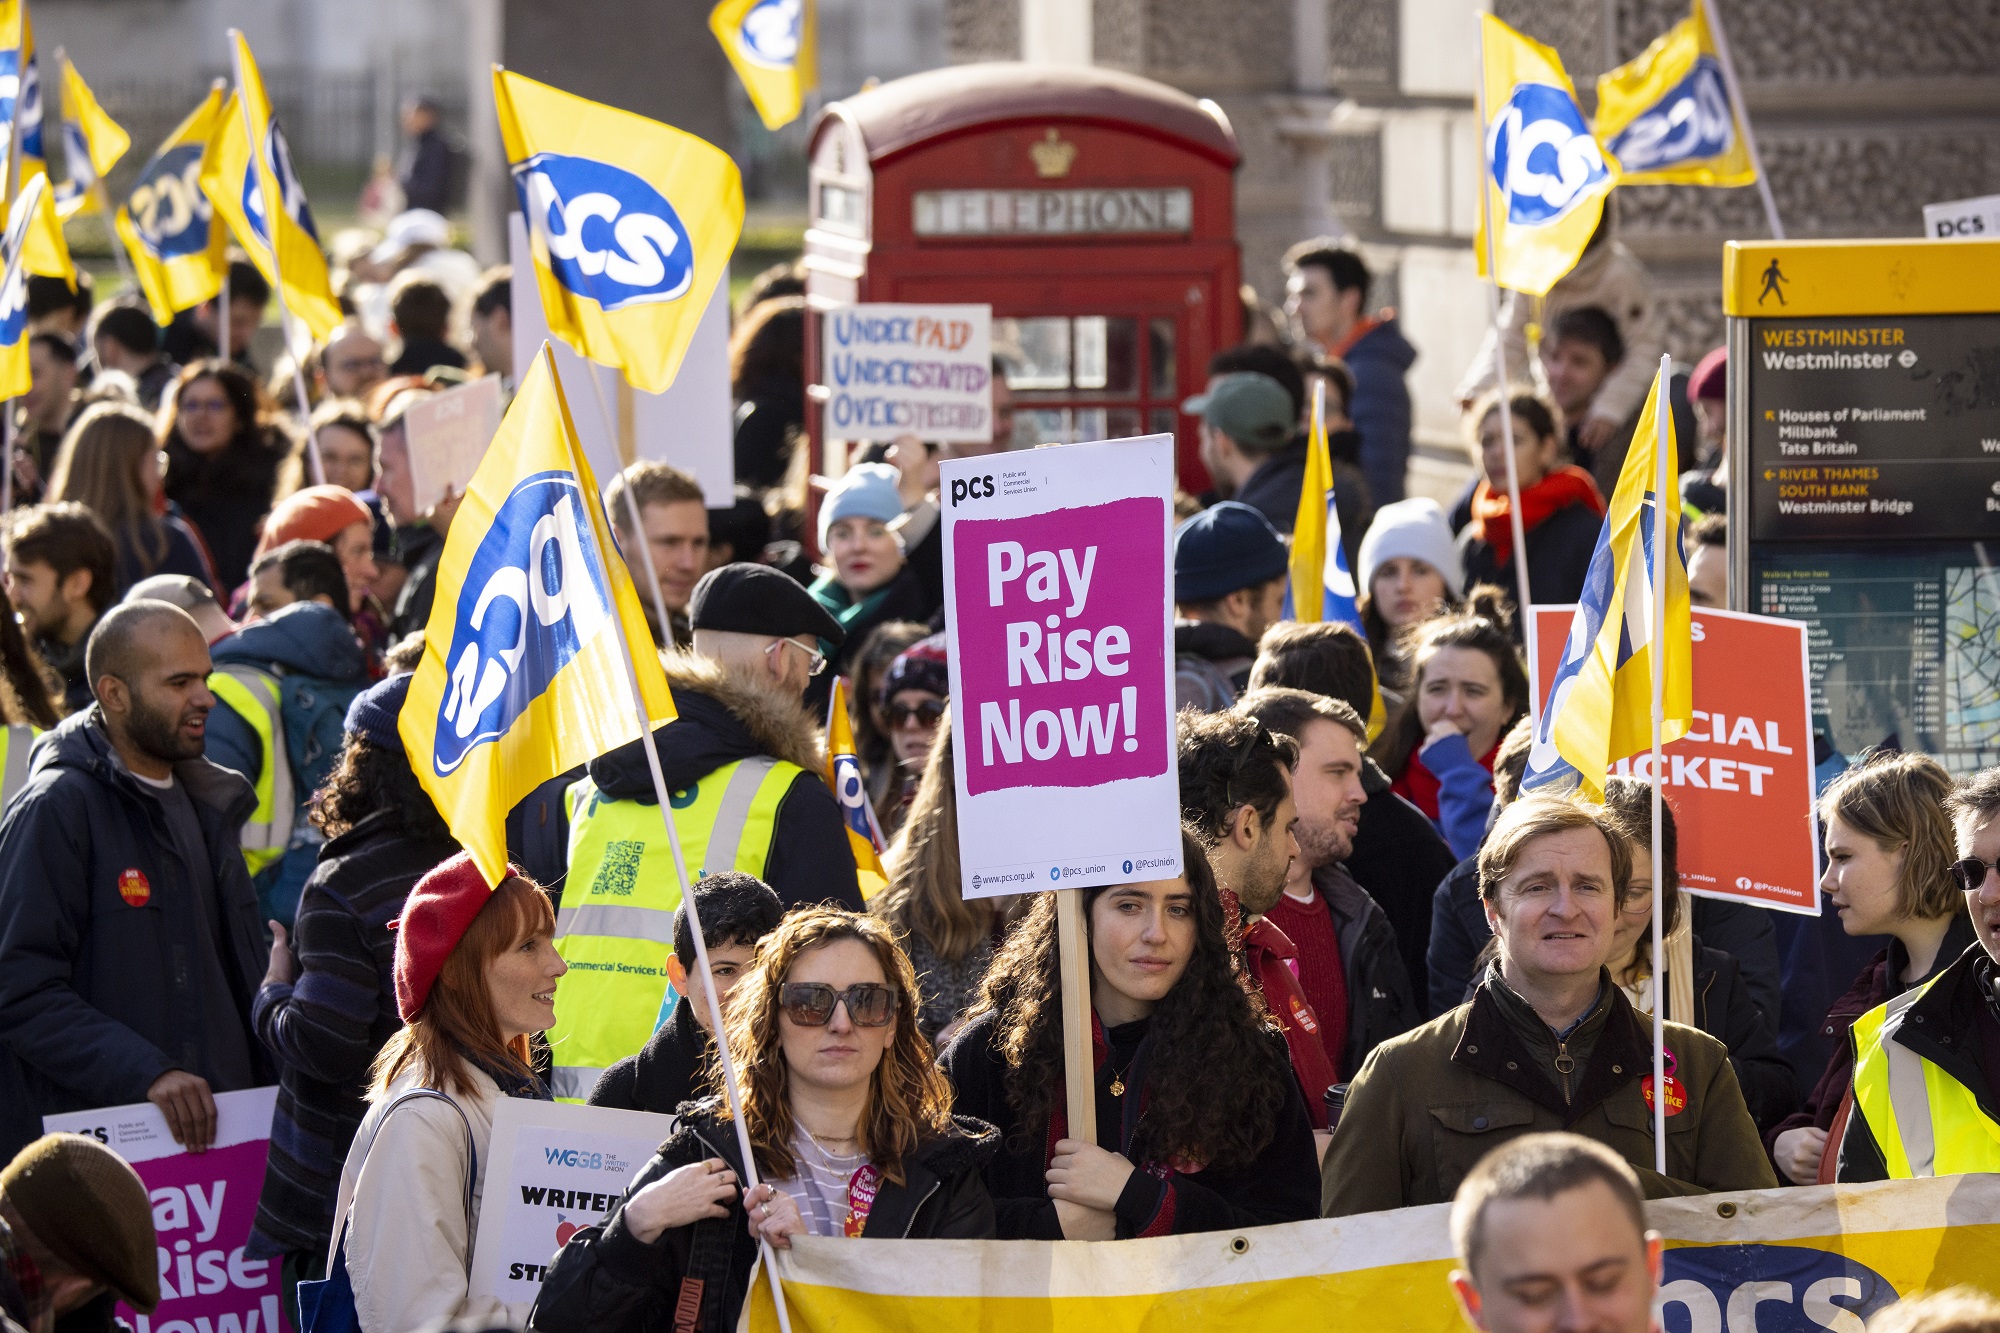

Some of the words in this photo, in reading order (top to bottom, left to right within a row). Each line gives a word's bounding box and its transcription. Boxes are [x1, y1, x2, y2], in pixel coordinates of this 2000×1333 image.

[926, 191, 1184, 233] TELEPHONE
[1763, 328, 1905, 347] WESTMINSTER
[1763, 350, 1892, 370] Westminster
[1779, 409, 1830, 423] Houses
[1833, 408, 1848, 422] of
[1852, 408, 1927, 421] Parliament
[1779, 425, 1838, 439] Millbank
[1779, 442, 1809, 455] Tate
[1812, 441, 1858, 455] Britain
[1779, 468, 1818, 481] RIVER
[1824, 467, 1879, 480] THAMES
[952, 475, 995, 508] pcs
[1004, 479, 1031, 487] Commercial
[1779, 485, 1826, 498] SOUTH
[1831, 484, 1869, 496] BANK
[1004, 488, 1023, 496] Services
[1779, 500, 1867, 514] Westminster
[1870, 499, 1914, 515] Bridge
[987, 541, 1098, 619] Pay
[1006, 614, 1131, 688] Rise
[980, 686, 1138, 767] Now!
[1684, 710, 1793, 756] CIAL
[1606, 753, 1774, 796] ICKET
[983, 870, 1035, 884] www.pcs.org.uk
[1062, 864, 1106, 878] @pcs_union
[1135, 857, 1175, 871] @PcsUnion
[1753, 882, 1803, 897] @PcsUnion
[616, 963, 657, 976] Services
[1664, 1076, 1674, 1084] cs
[1645, 1090, 1682, 1108] STIKE
[1664, 1086, 1673, 1096] N
[545, 1147, 603, 1170] WGGB
[856, 1176, 876, 1193] Rise
[150, 1180, 227, 1242] ay
[853, 1200, 869, 1210] pcs
